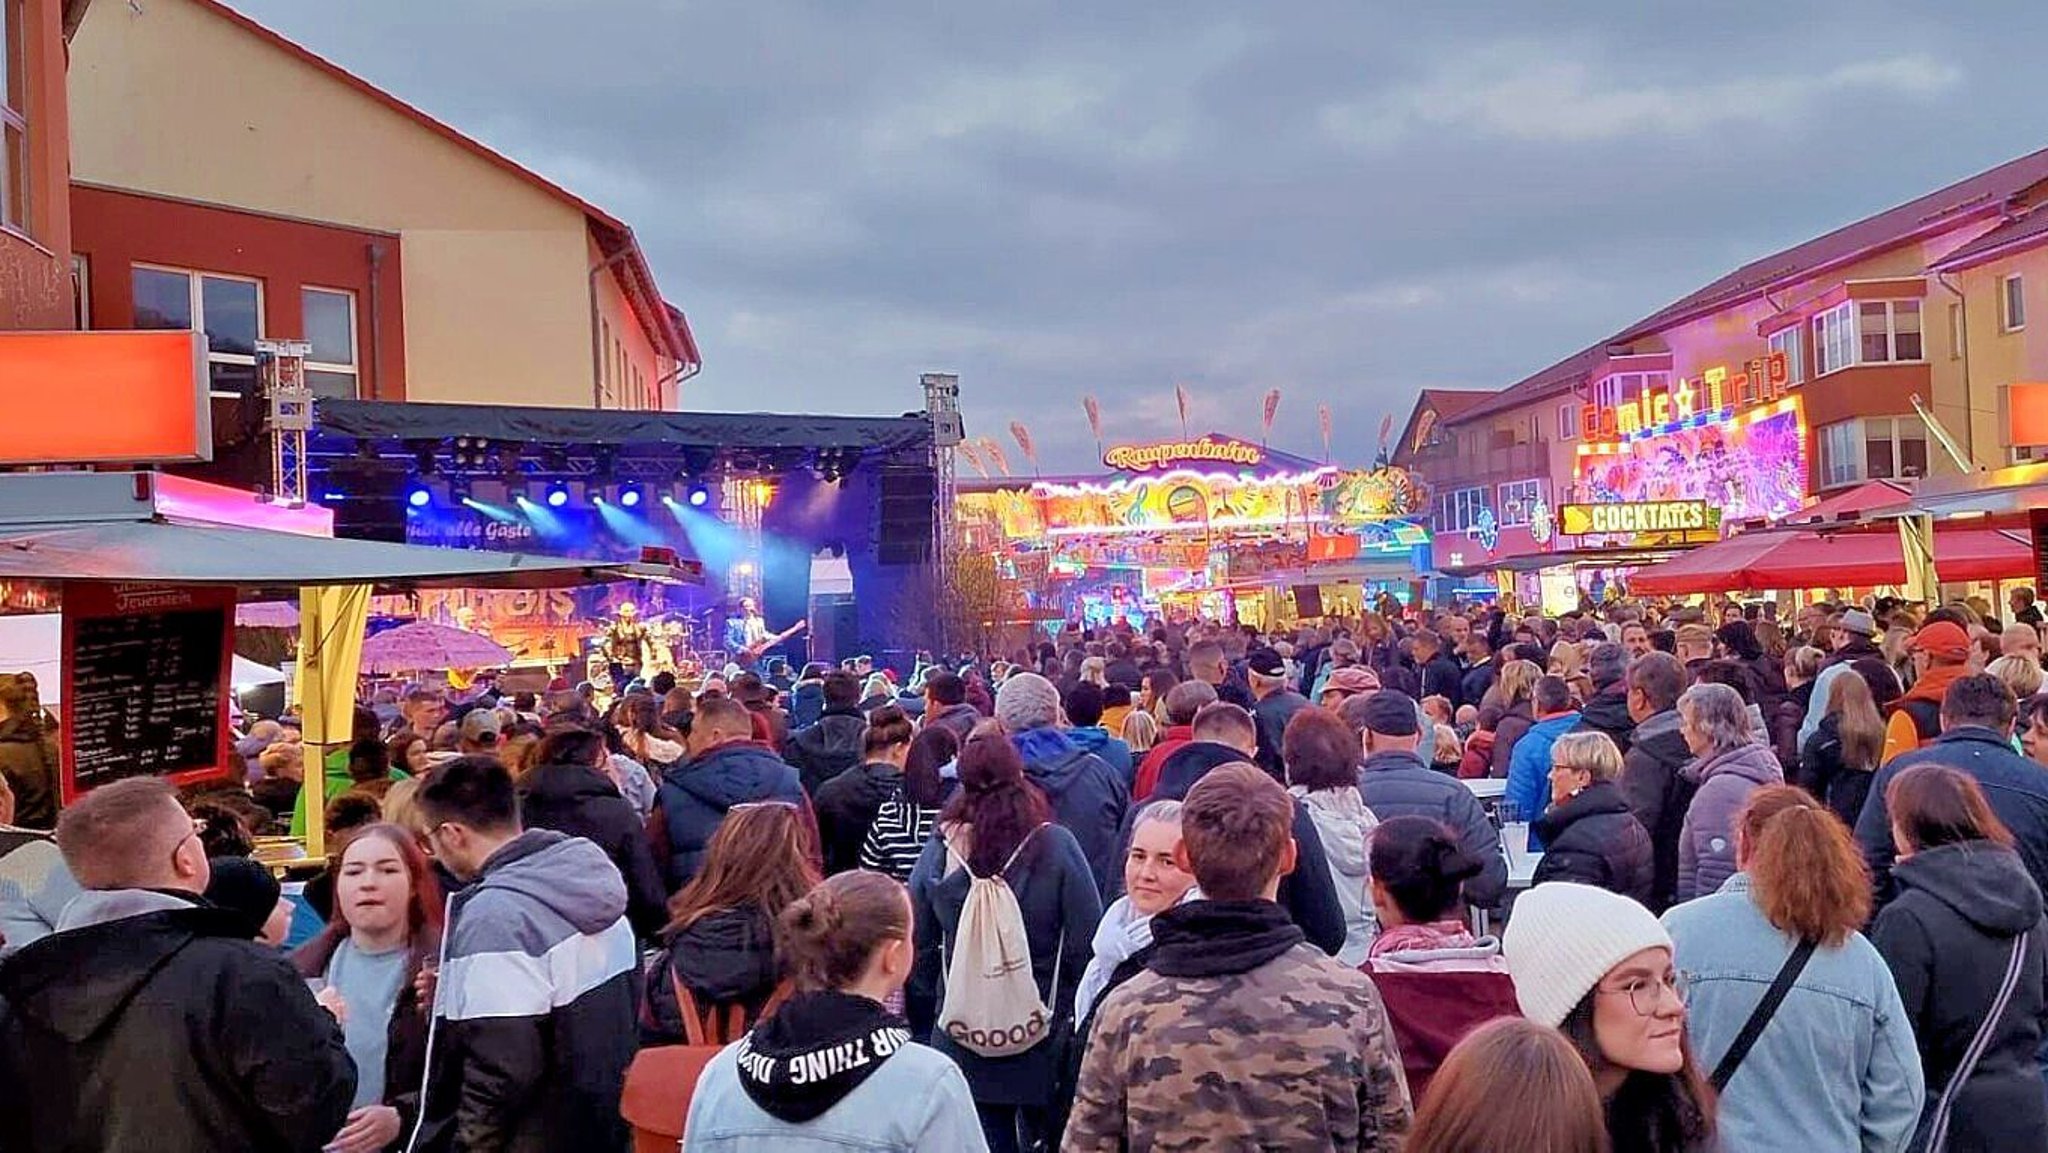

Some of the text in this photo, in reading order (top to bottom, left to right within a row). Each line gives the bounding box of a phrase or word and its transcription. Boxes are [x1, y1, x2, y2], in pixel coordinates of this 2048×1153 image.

[1106, 438, 1261, 472] Raupenbahn
[485, 521, 532, 540] Gäste
[1592, 502, 1703, 532] COCKTAILS
[947, 1010, 1044, 1047] Goood
[789, 1038, 870, 1085] THING
